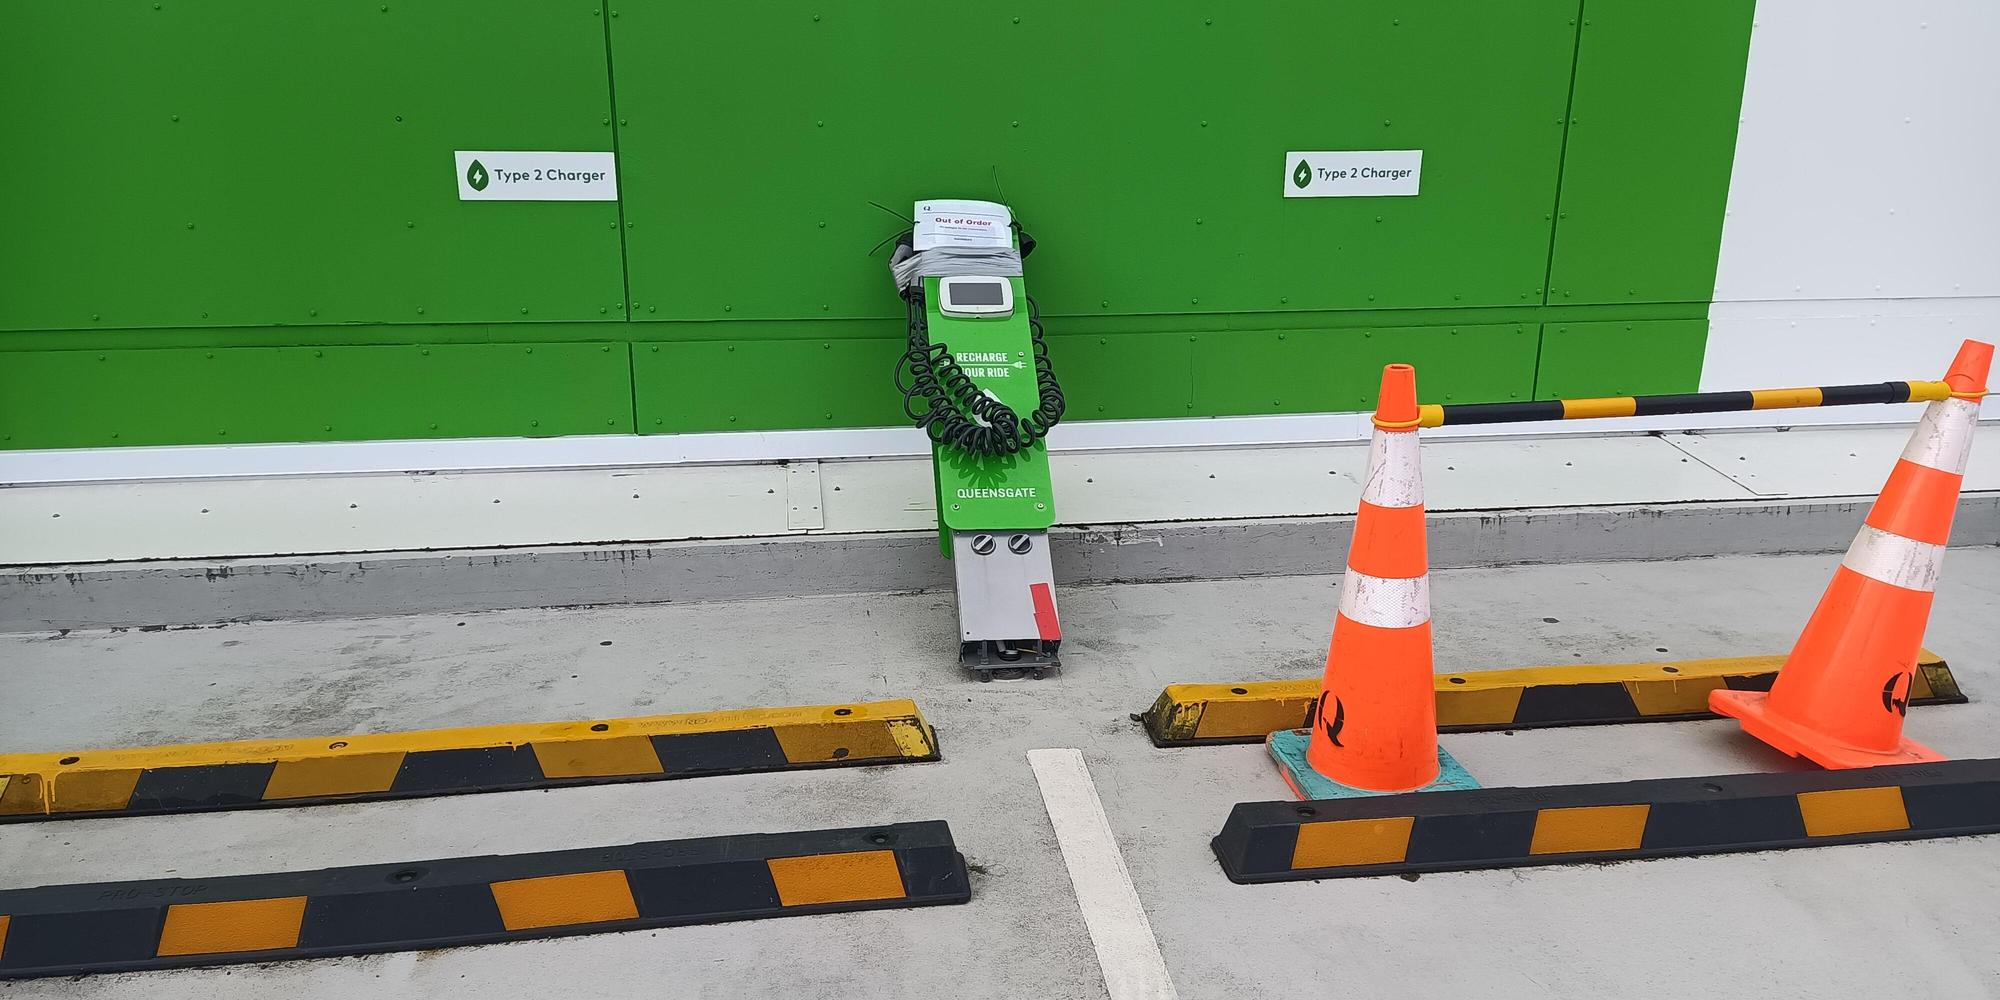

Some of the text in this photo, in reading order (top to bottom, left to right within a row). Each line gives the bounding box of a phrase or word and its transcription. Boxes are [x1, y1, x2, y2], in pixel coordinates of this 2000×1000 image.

[494, 169, 606, 184] Type 2 Charger
[1318, 167, 1412, 181] Type 2 Charger
[956, 352, 1008, 362] RECHARGE
[987, 367, 1010, 378] RIDE
[957, 487, 1037, 499] QUEENSGATE
